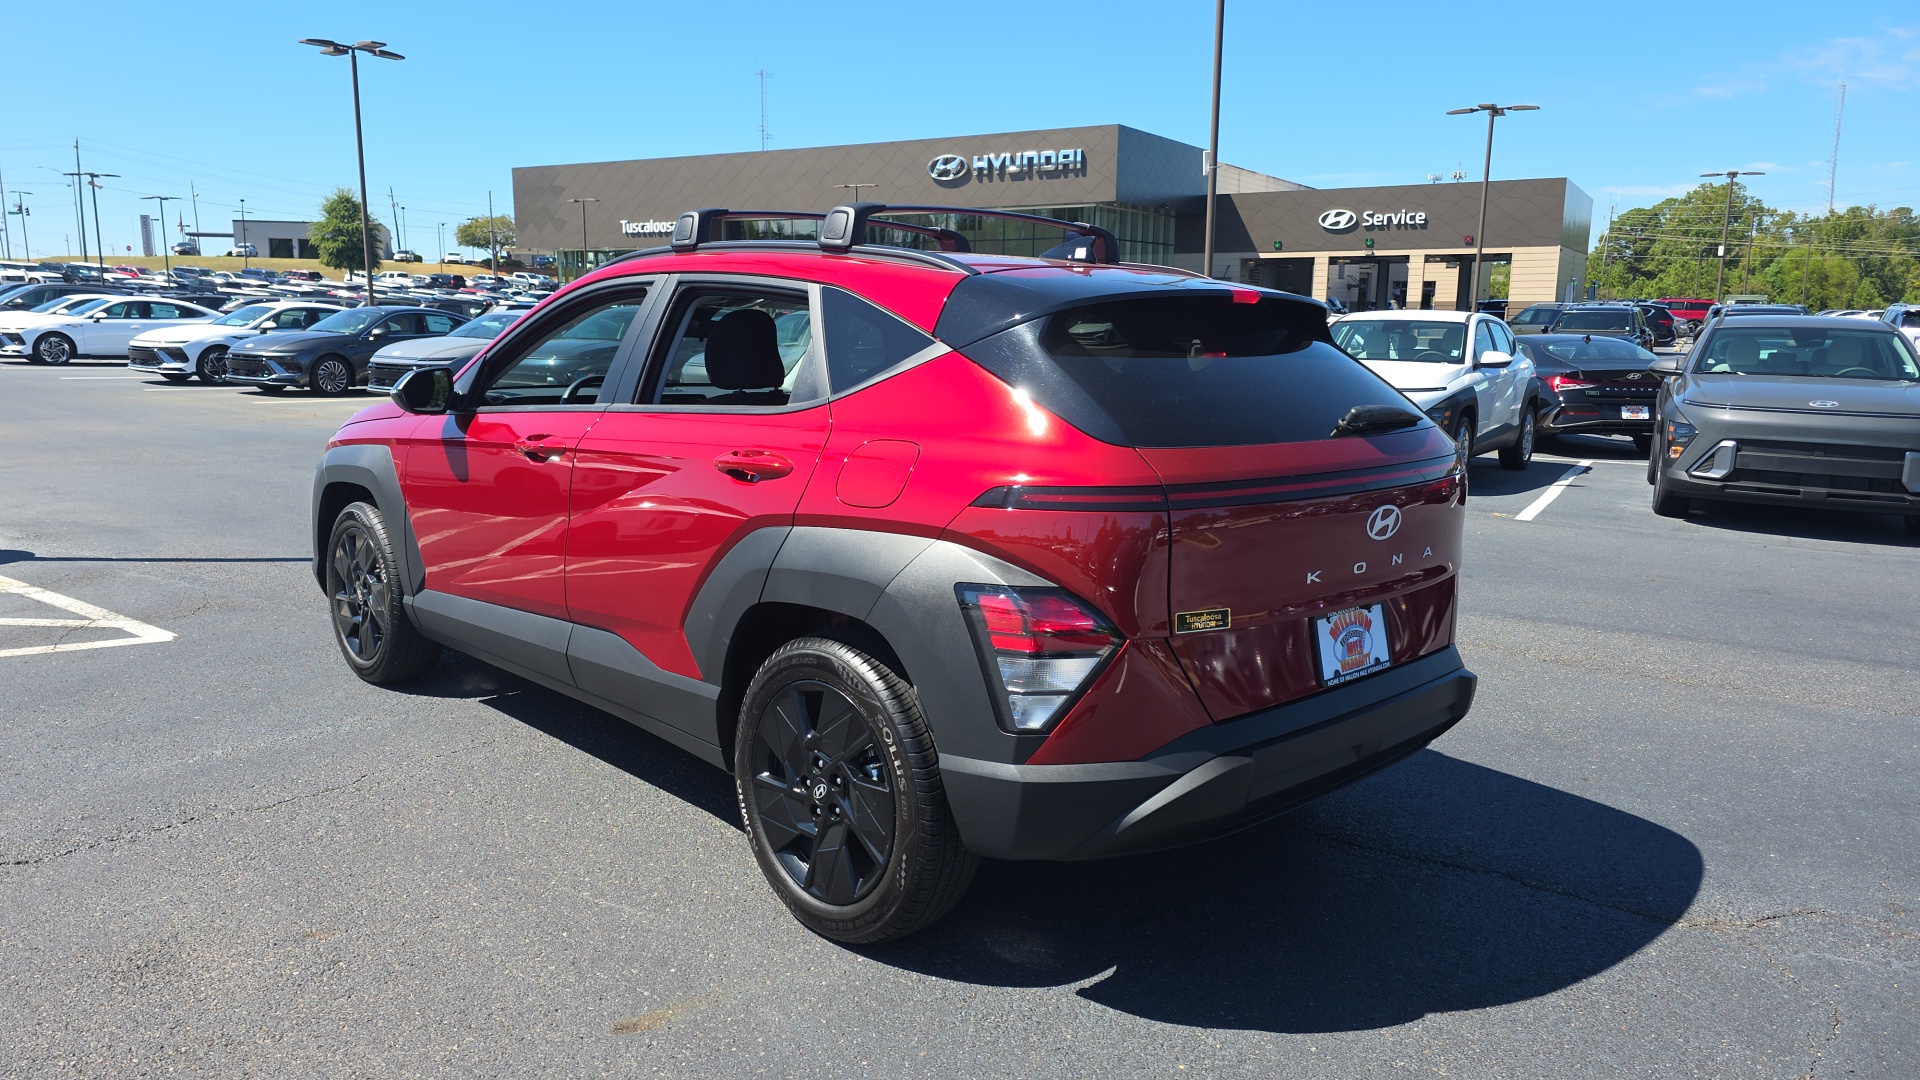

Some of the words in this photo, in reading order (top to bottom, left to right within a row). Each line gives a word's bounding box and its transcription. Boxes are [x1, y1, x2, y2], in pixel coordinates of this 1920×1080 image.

[973, 149, 1082, 176] HYUNDAI
[1362, 209, 1426, 226] Service
[1306, 546, 1432, 585] KONA
[1185, 613, 1222, 623] Tuscaloosa
[1329, 610, 1372, 642] MILLION
[1346, 639, 1363, 657] MILE
[875, 713, 908, 792] SOLUS
